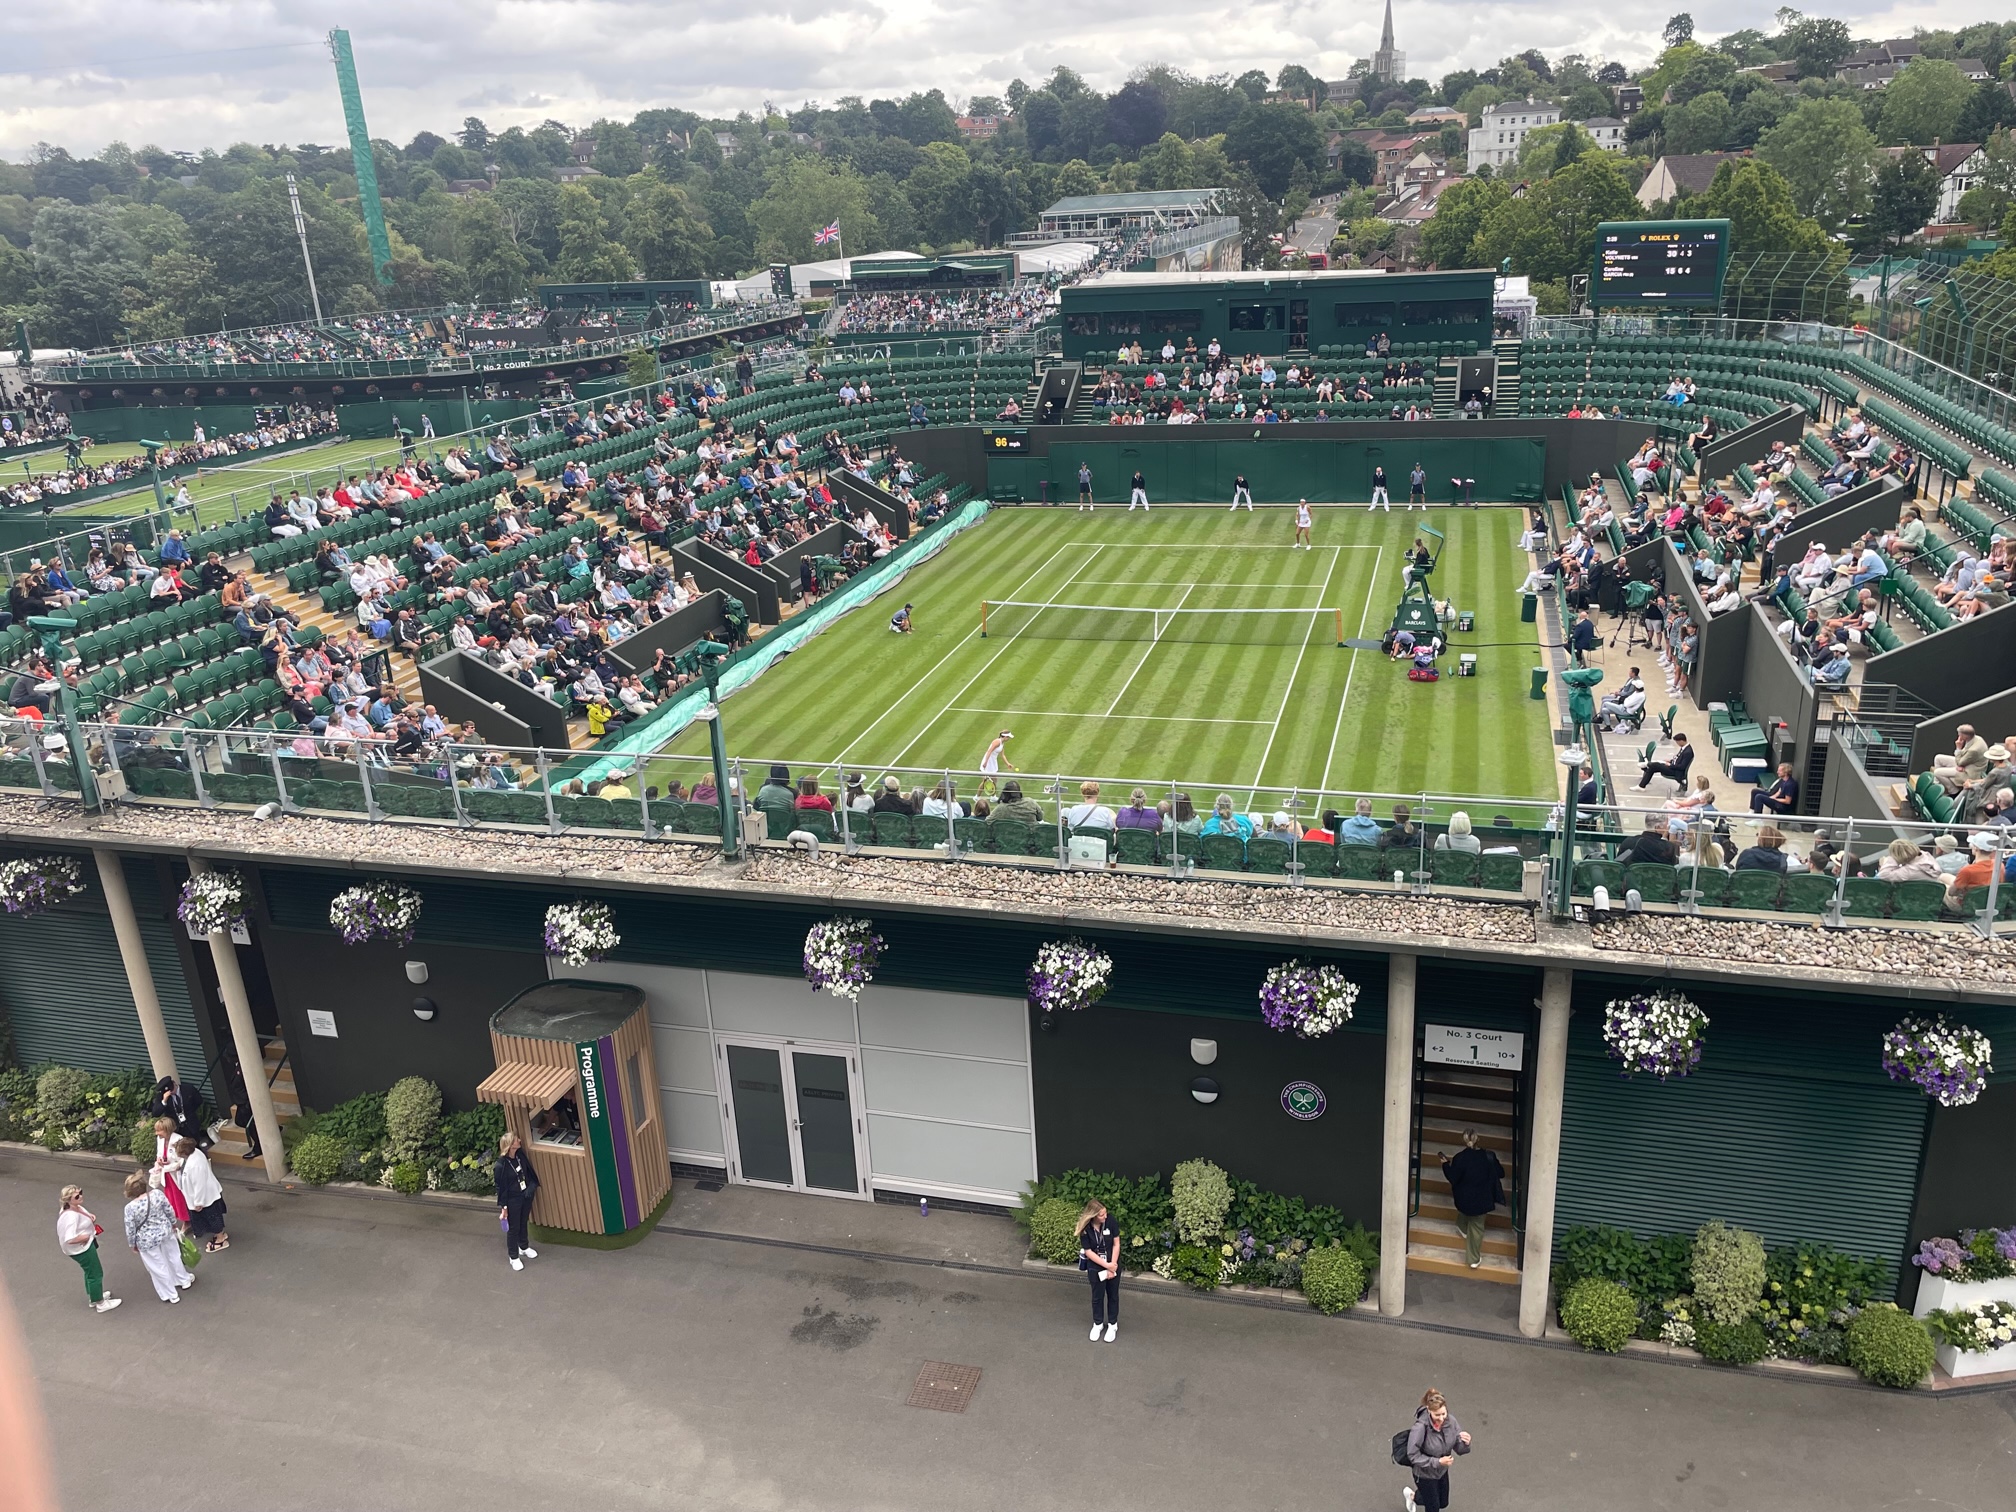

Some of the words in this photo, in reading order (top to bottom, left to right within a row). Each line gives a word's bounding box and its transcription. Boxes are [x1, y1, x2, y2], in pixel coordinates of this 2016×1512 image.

[1665, 267, 1676, 275] 15
[504, 361, 531, 369] COURT
[1475, 368, 1481, 376] 7
[995, 437, 1008, 447] 96
[1446, 1029, 1463, 1038] No.
[1466, 1031, 1472, 1039] 3
[1475, 1032, 1503, 1042] Court
[1470, 1045, 1478, 1060] 1
[1498, 1051, 1508, 1059] 10
[1445, 1057, 1475, 1065] Reserved
[1476, 1060, 1500, 1068] Seating
[580, 1047, 600, 1118] Programme
[1288, 1083, 1324, 1102] CHAMPIONSHIPS
[1288, 1108, 1319, 1119] WIMBLEDON
